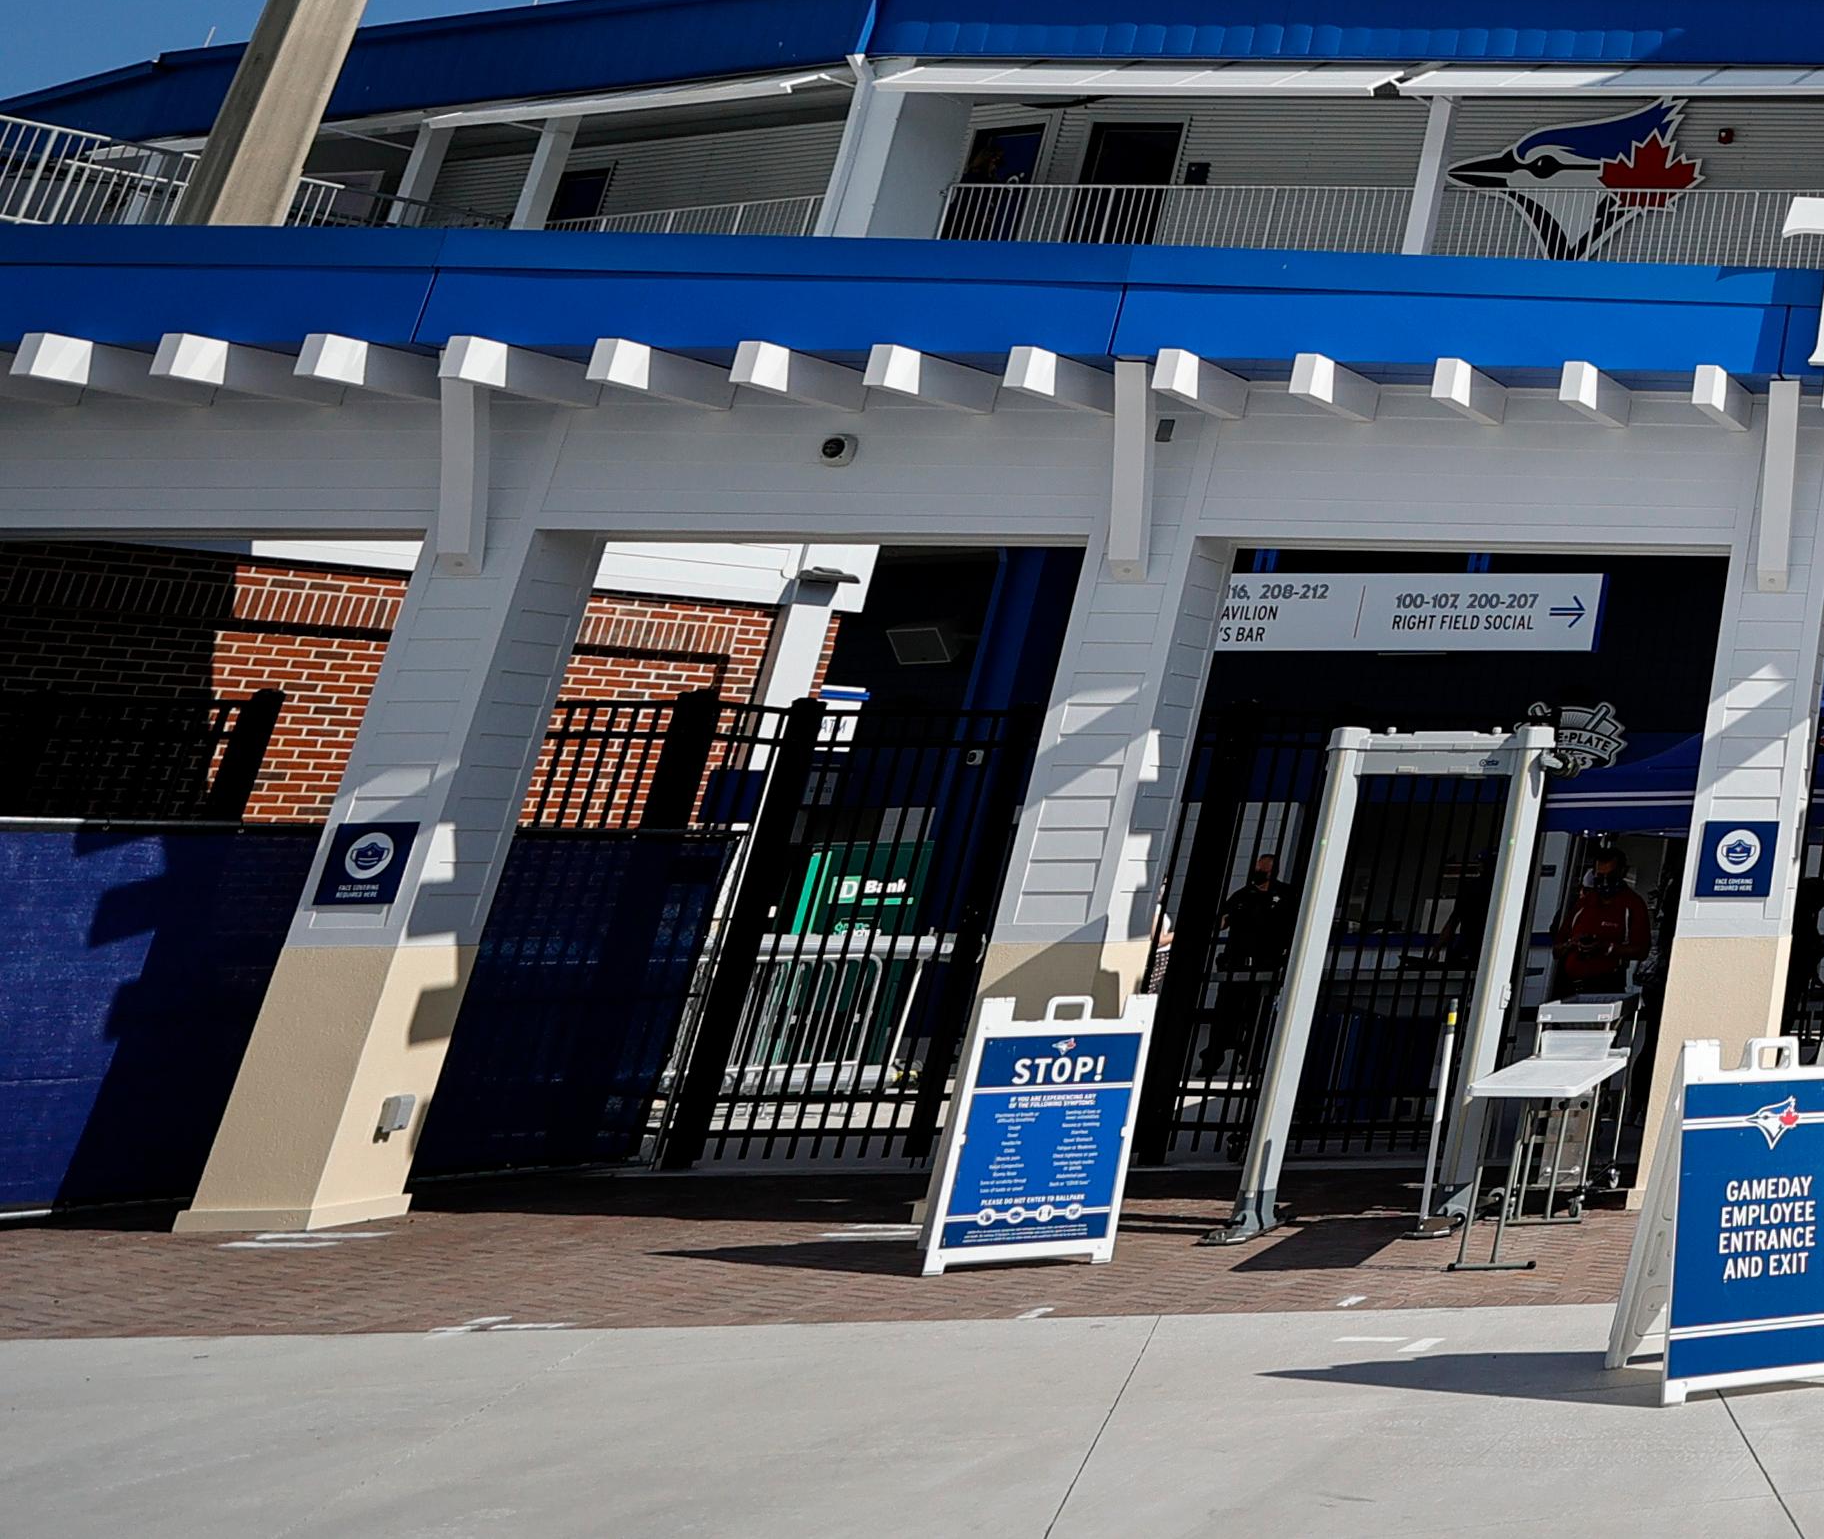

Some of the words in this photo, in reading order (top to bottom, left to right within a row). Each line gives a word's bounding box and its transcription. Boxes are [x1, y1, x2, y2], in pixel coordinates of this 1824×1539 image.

[1259, 583, 1329, 599] 208-212
[1466, 593, 1540, 609] 200-207
[1220, 605, 1279, 621] AVILION
[1391, 615, 1436, 630] RIGHT
[1439, 615, 1480, 630] FIELD
[1483, 614, 1535, 630] SOCIAL
[1220, 626, 1232, 642] 'S
[1235, 626, 1266, 642] BAR
[1011, 1055, 1106, 1085] STOP!
[1726, 1175, 1813, 1202] GAMEDAY
[1721, 1200, 1816, 1228] EMPLOYEE
[1718, 1225, 1816, 1254] ENTRANCE
[1723, 1255, 1763, 1280] AND
[1768, 1252, 1809, 1276] EXIT
